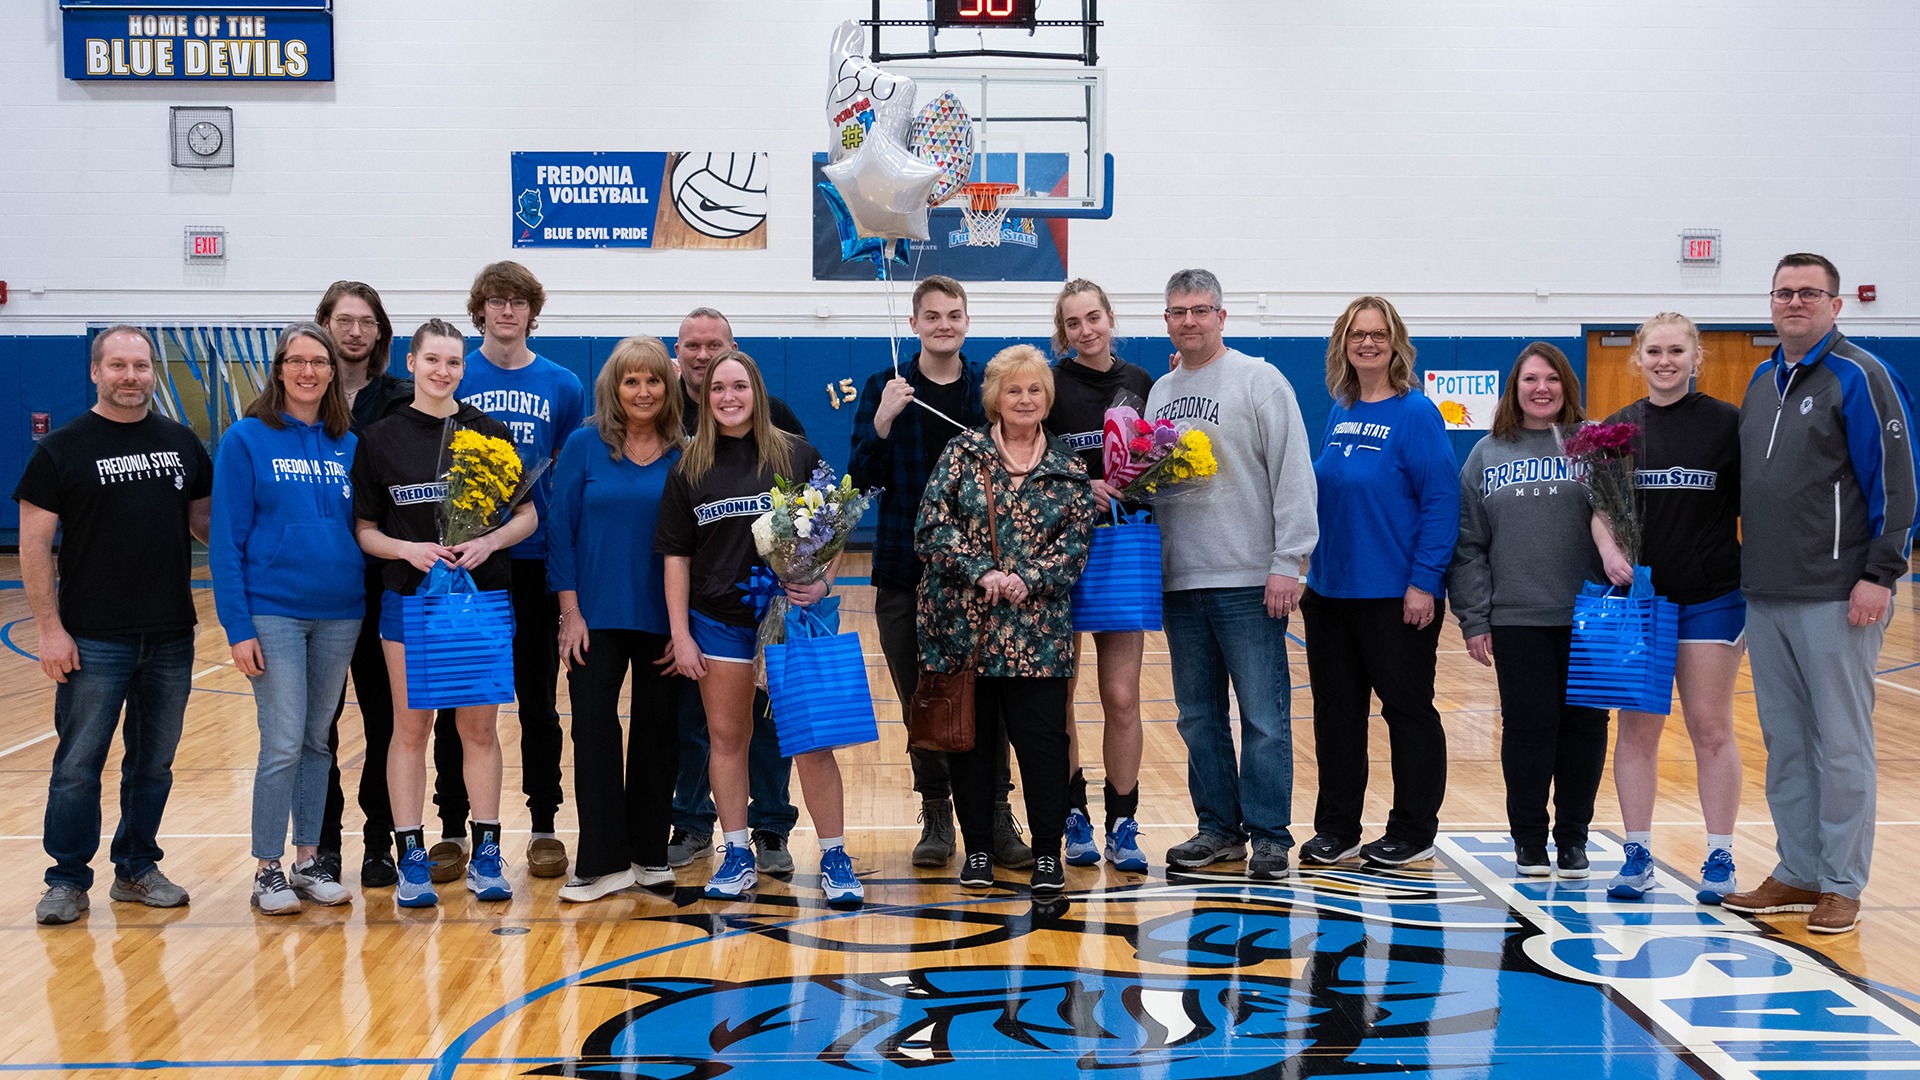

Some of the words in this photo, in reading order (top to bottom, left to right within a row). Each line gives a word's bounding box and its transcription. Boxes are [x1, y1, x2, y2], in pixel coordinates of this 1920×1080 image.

[128, 15, 188, 37] HOME
[194, 15, 220, 37] OF
[226, 15, 266, 37] THE
[86, 38, 174, 76] BLUE
[184, 39, 308, 77] DEVILS
[537, 166, 634, 185] FREDONIA
[549, 187, 649, 204] VOLLEYBALL
[544, 227, 573, 240] BLUE
[577, 227, 610, 240] DEVIL
[612, 227, 648, 240] PRIDE
[1004, 229, 1036, 245] STATE
[195, 237, 218, 254] EXIT
[1689, 240, 1712, 258] EXIT
[1437, 375, 1496, 395] POTTER
[1362, 423, 1391, 439] STATE
[1061, 434, 1104, 448] FREDO
[96, 453, 151, 476] FREDONIA
[149, 451, 183, 470] STATE
[272, 458, 323, 476] FREDONIA
[323, 460, 349, 479] STATE
[100, 467, 187, 485] BASKETBALL
[1670, 471, 1714, 486] STATE
[699, 501, 758, 521] FREDONIA
